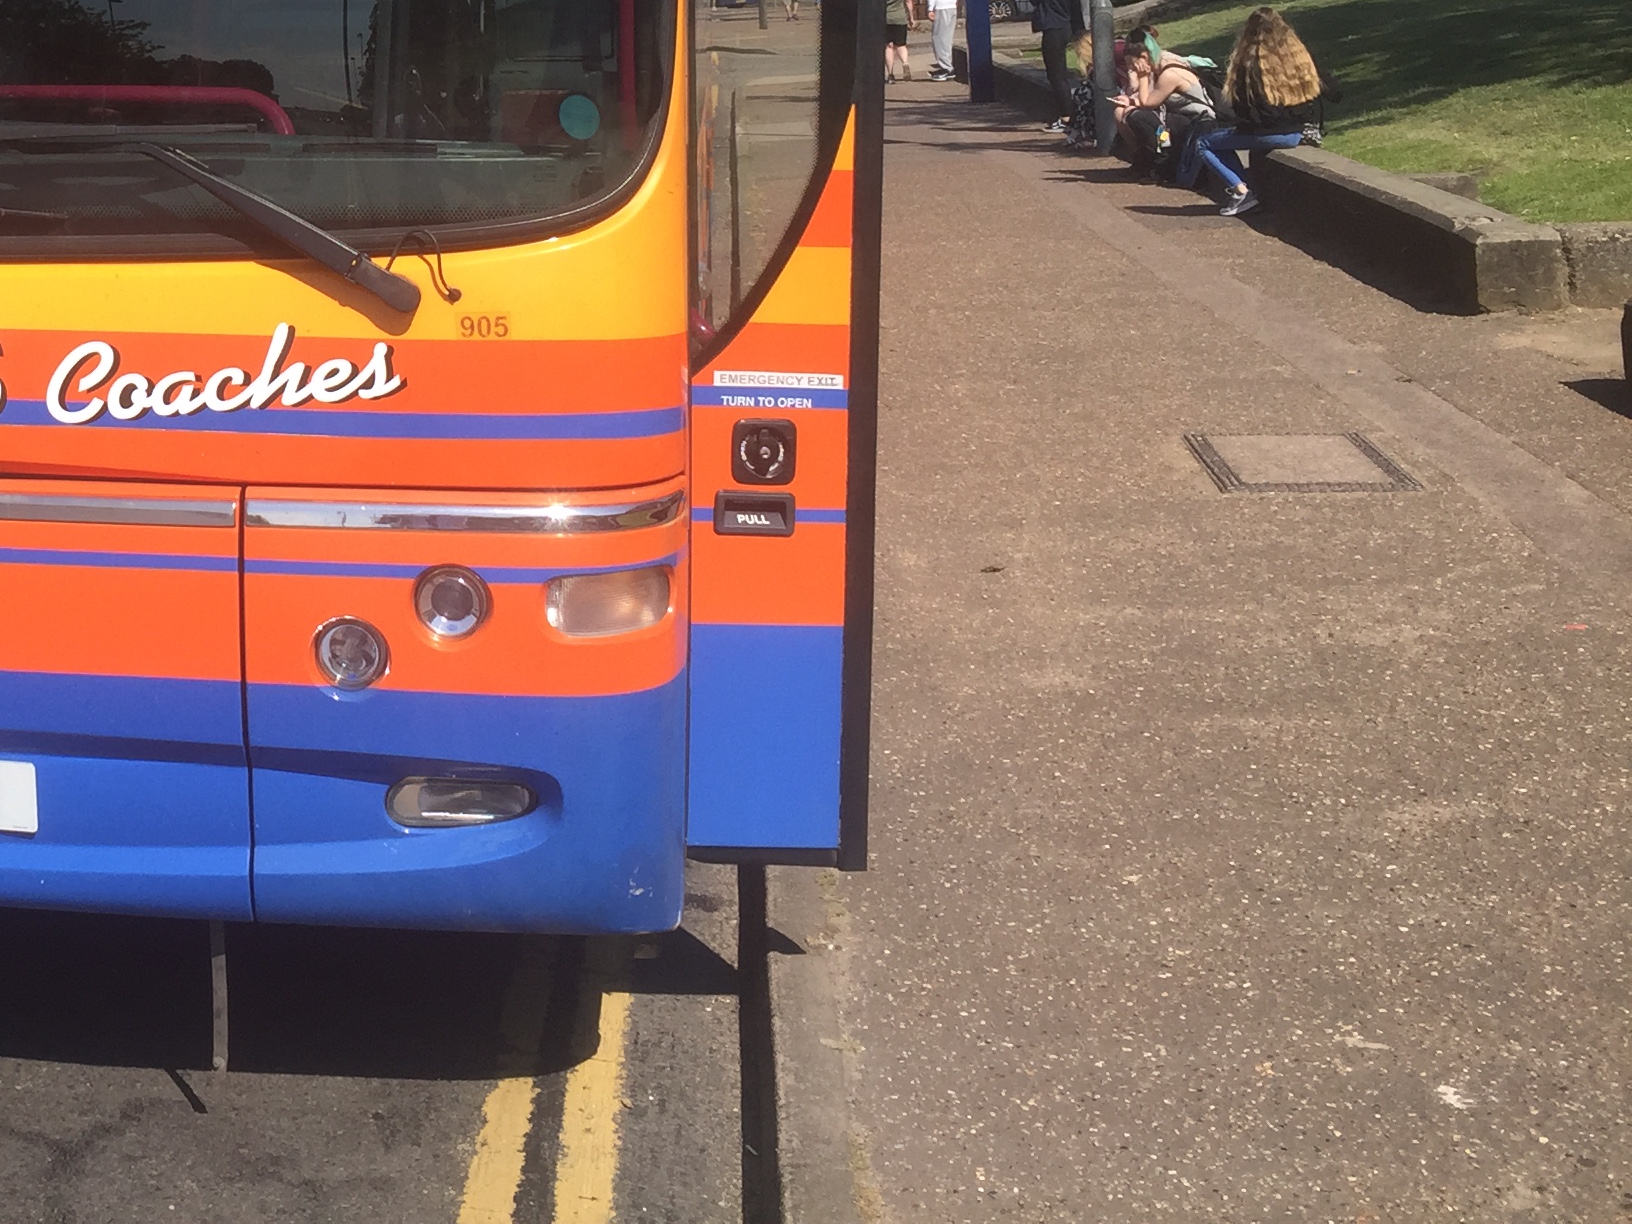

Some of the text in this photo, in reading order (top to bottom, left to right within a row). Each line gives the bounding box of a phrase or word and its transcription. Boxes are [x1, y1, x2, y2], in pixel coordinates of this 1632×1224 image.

[459, 315, 510, 339] 905
[45, 322, 406, 425] Coaches
[719, 373, 839, 387] EMERGENCY EXIT
[720, 395, 812, 409] TURN TO OPEN
[736, 514, 770, 525] PULL
